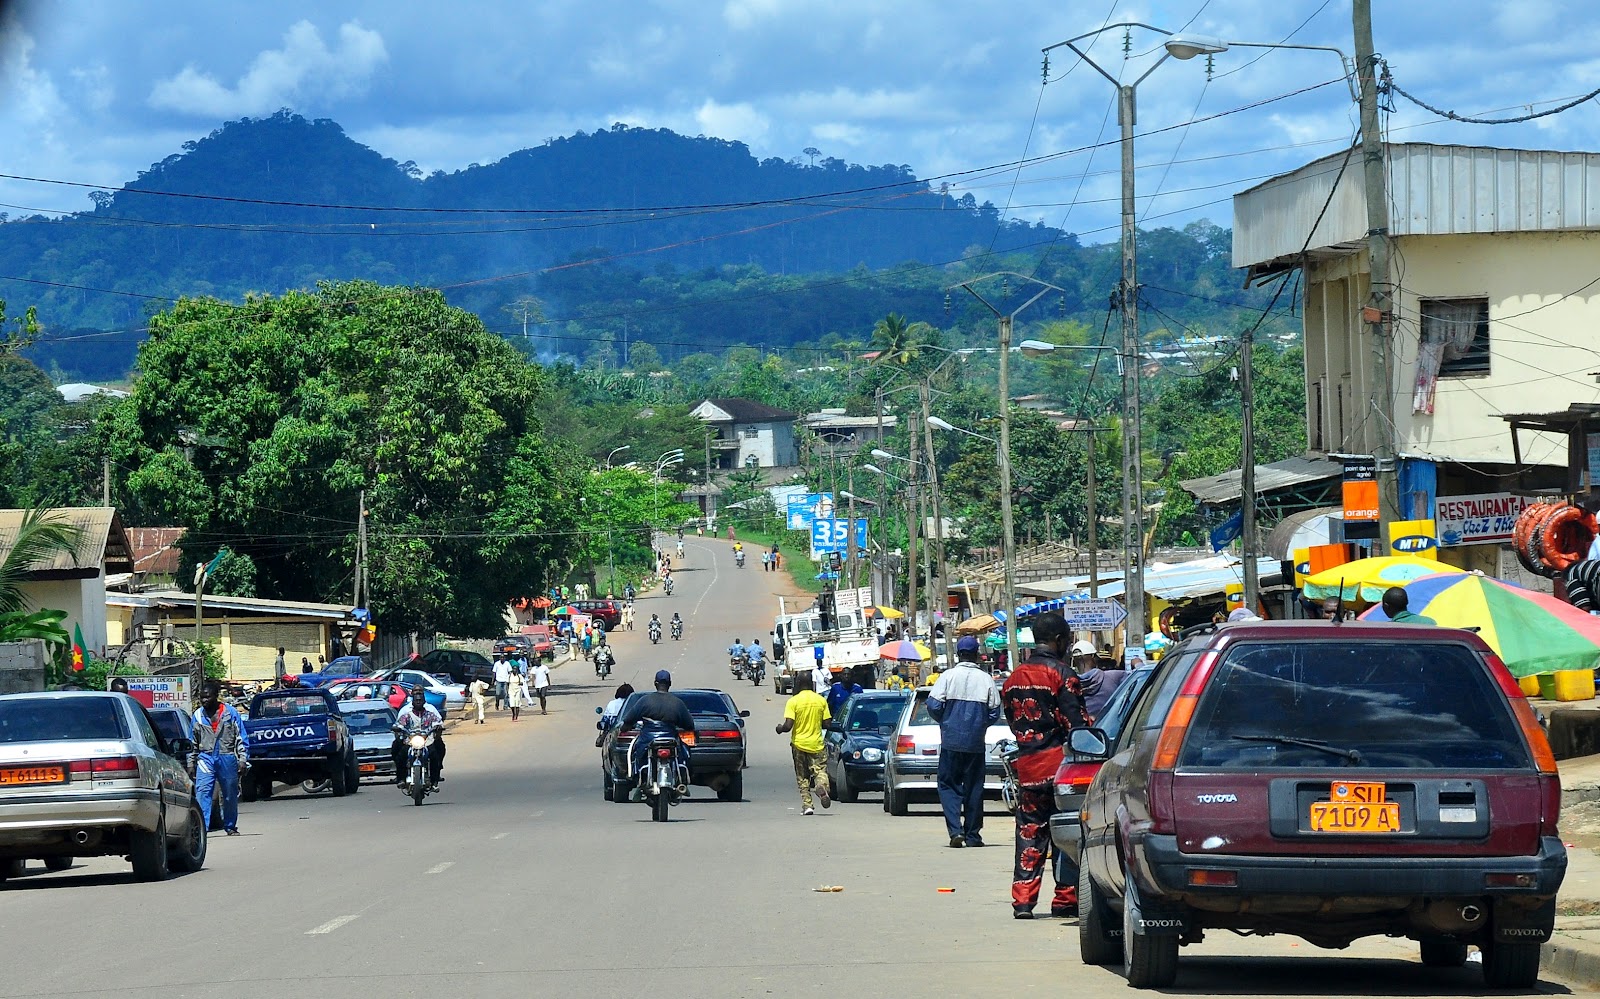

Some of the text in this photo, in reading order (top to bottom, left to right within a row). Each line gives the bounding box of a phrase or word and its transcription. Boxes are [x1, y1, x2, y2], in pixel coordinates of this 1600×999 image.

[1346, 509, 1378, 518] orange
[1438, 496, 1529, 521] RESTAURANT-A
[1400, 538, 1428, 549] MTN
[153, 692, 187, 701] ERNELLE
[254, 726, 315, 740] TOYOTA
[0, 768, 58, 782] LT 6111 S
[1197, 794, 1237, 803] TOYOTA
[1314, 807, 1390, 828] 7109 A
[1139, 919, 1183, 928] TOYOTA
[1502, 928, 1545, 937] TOYOTA
